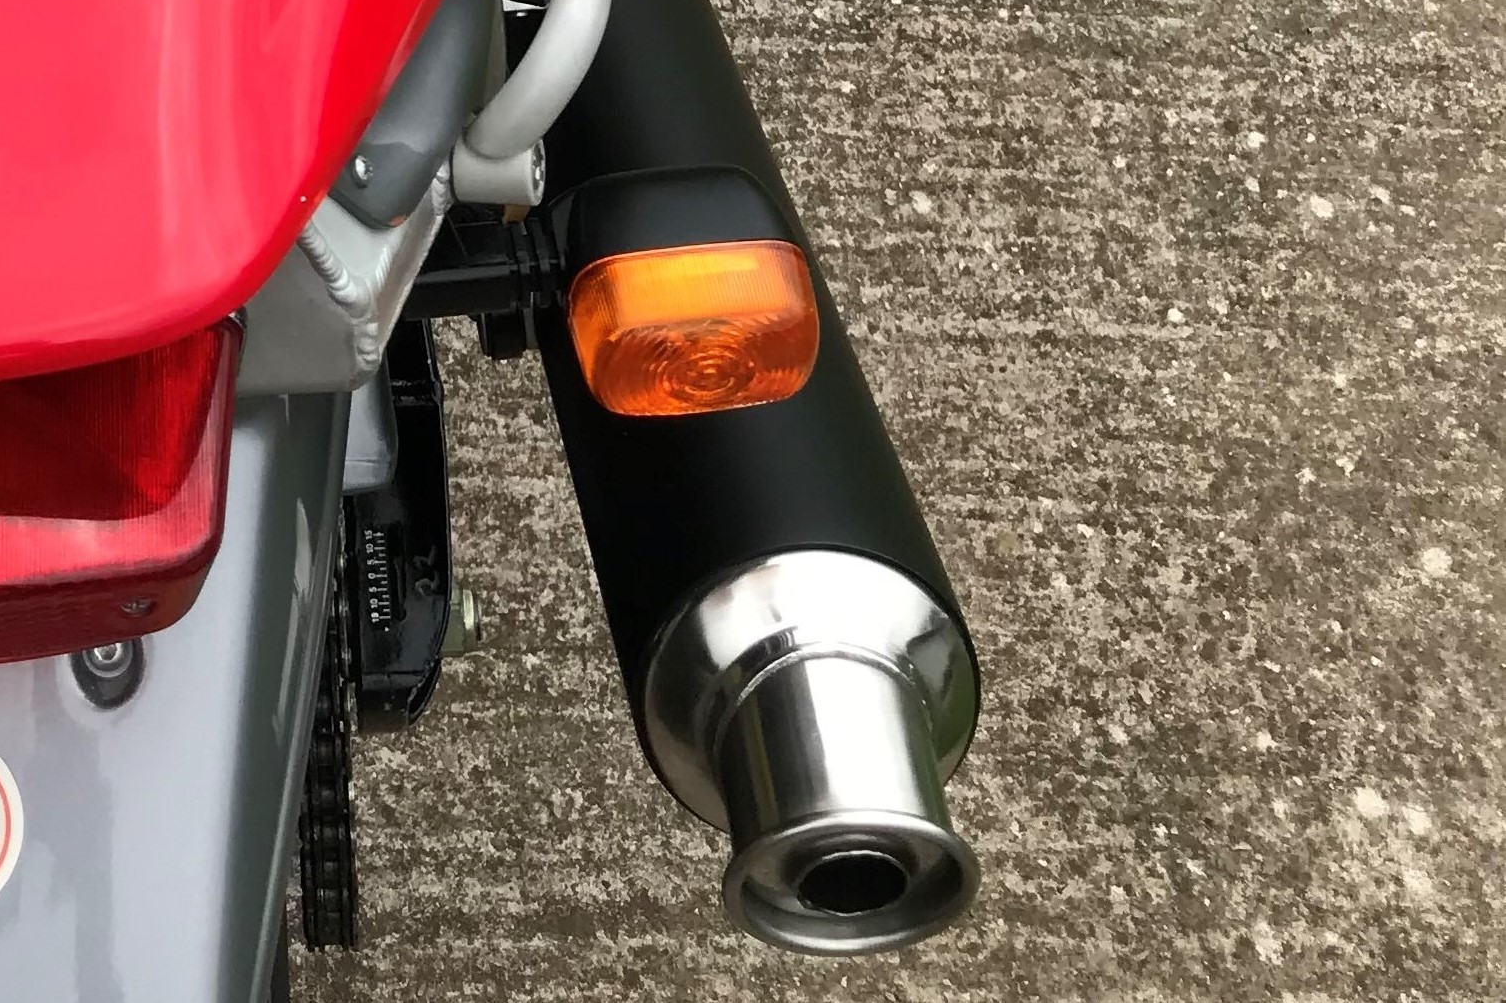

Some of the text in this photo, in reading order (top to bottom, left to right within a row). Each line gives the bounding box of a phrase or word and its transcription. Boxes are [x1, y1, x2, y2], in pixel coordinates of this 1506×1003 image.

[364, 530, 373, 540] 15
[365, 543, 374, 554] 10
[370, 598, 378, 609] 10
